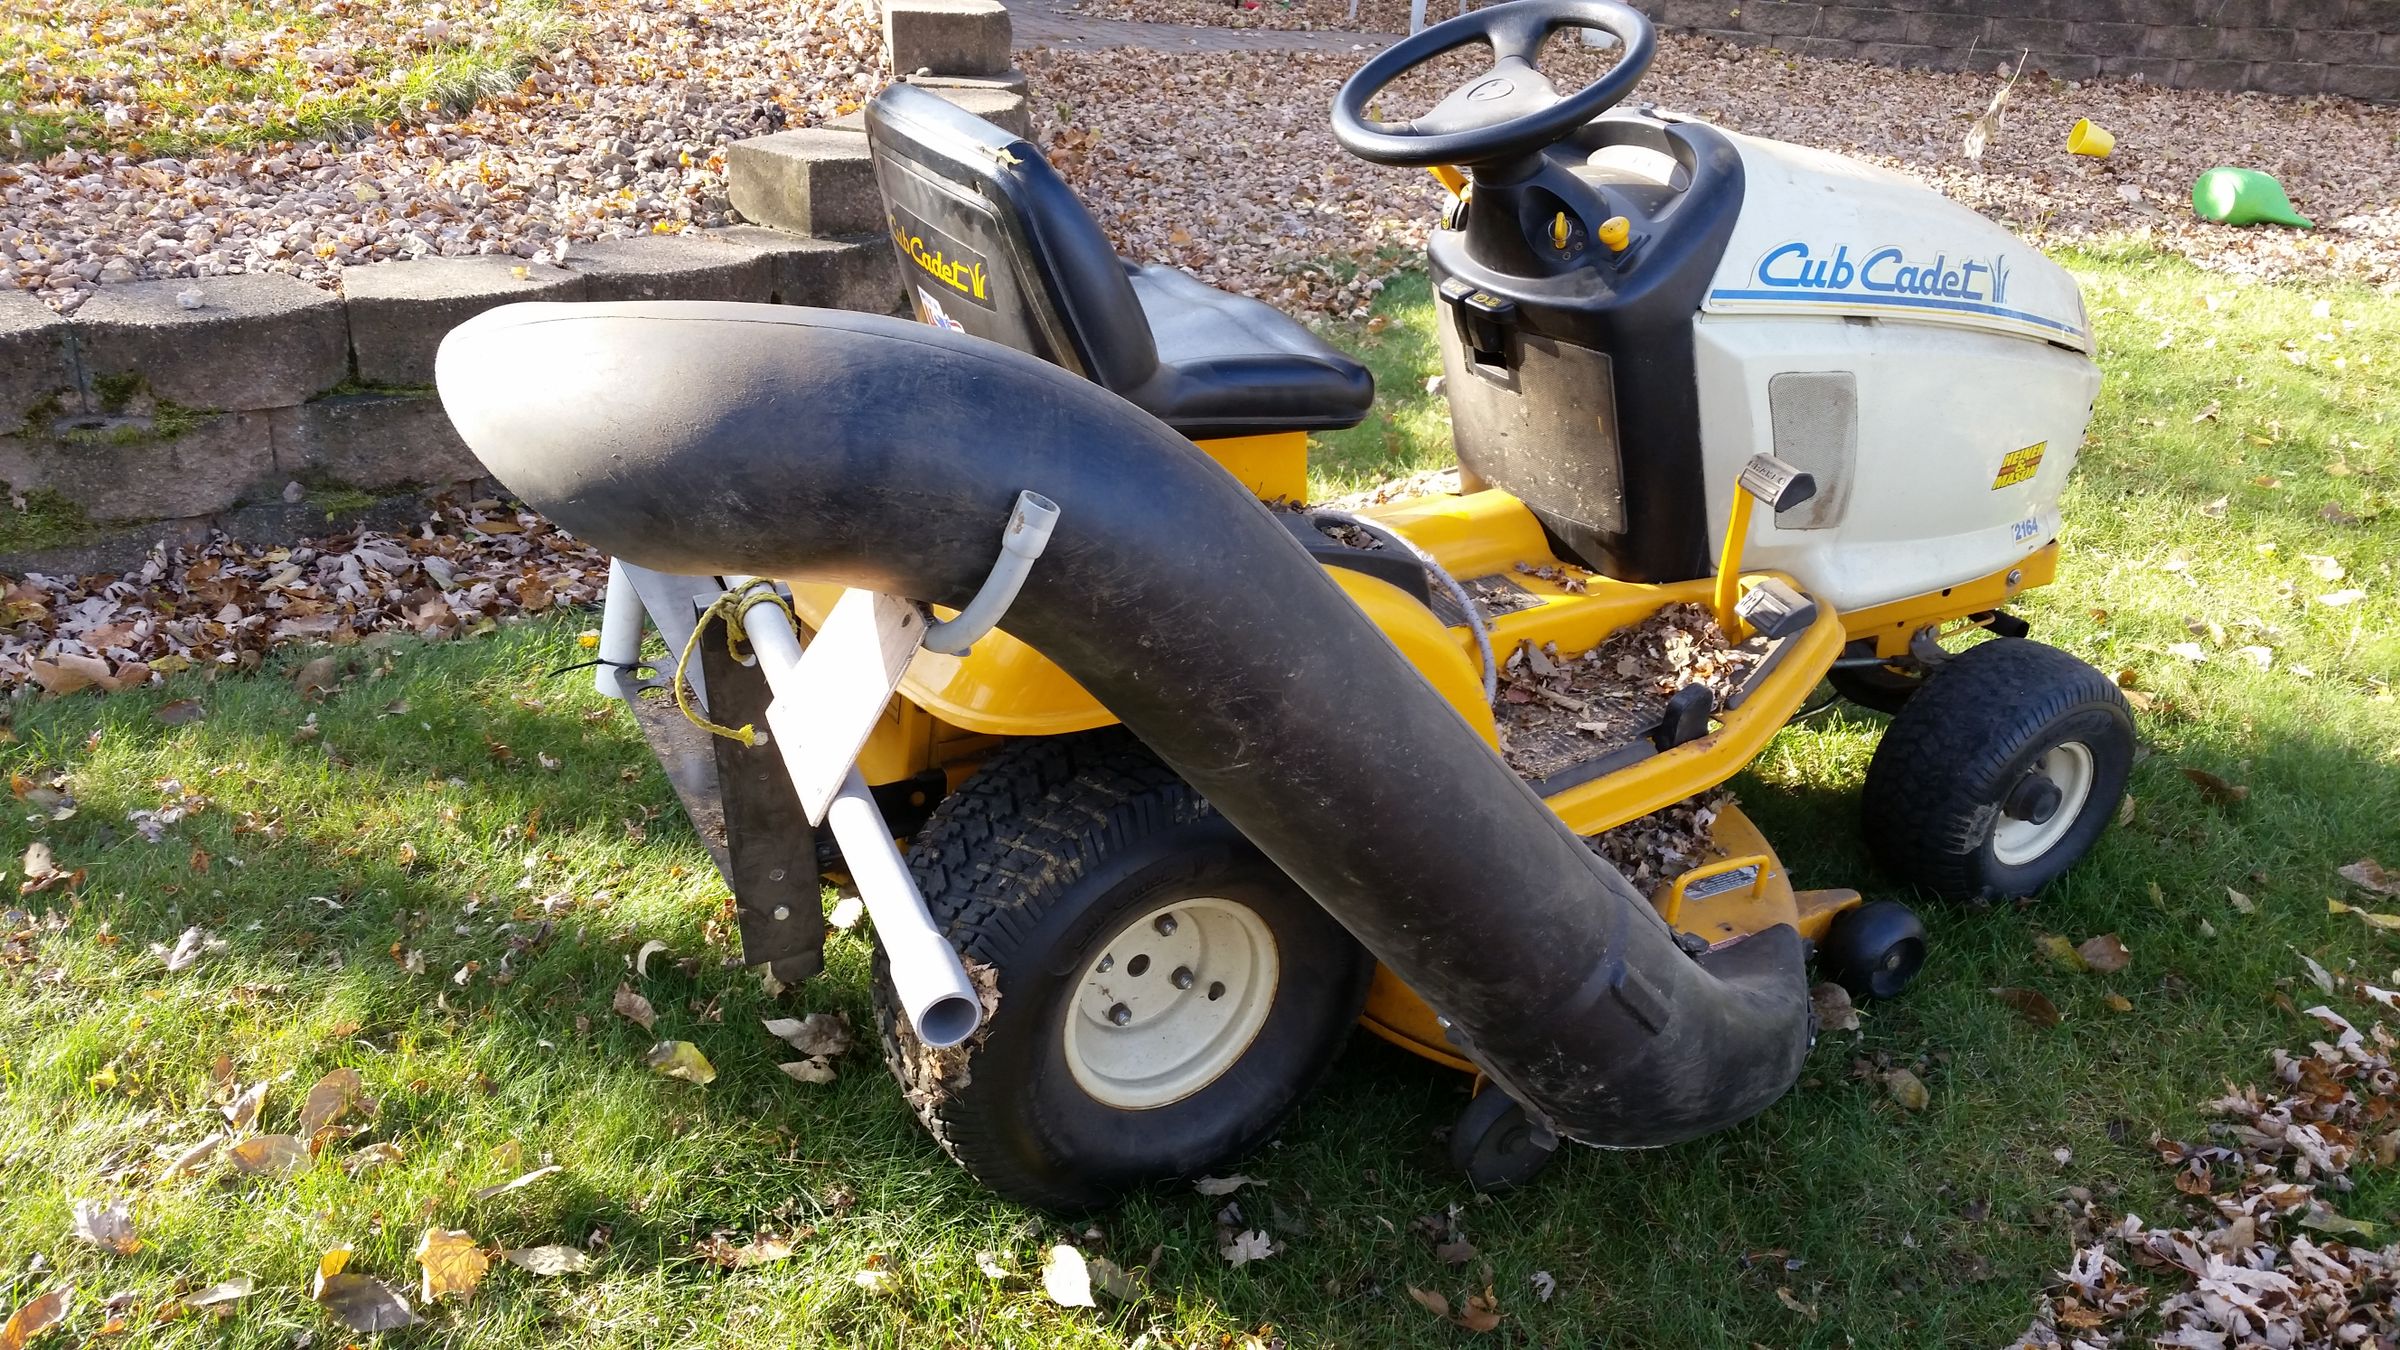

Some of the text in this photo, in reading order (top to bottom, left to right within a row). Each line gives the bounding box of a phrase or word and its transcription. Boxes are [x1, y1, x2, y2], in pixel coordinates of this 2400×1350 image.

[910, 236, 969, 293] Cadet
[1758, 242, 1988, 300] Cub Cadet
[2014, 517, 2038, 541] 2164
